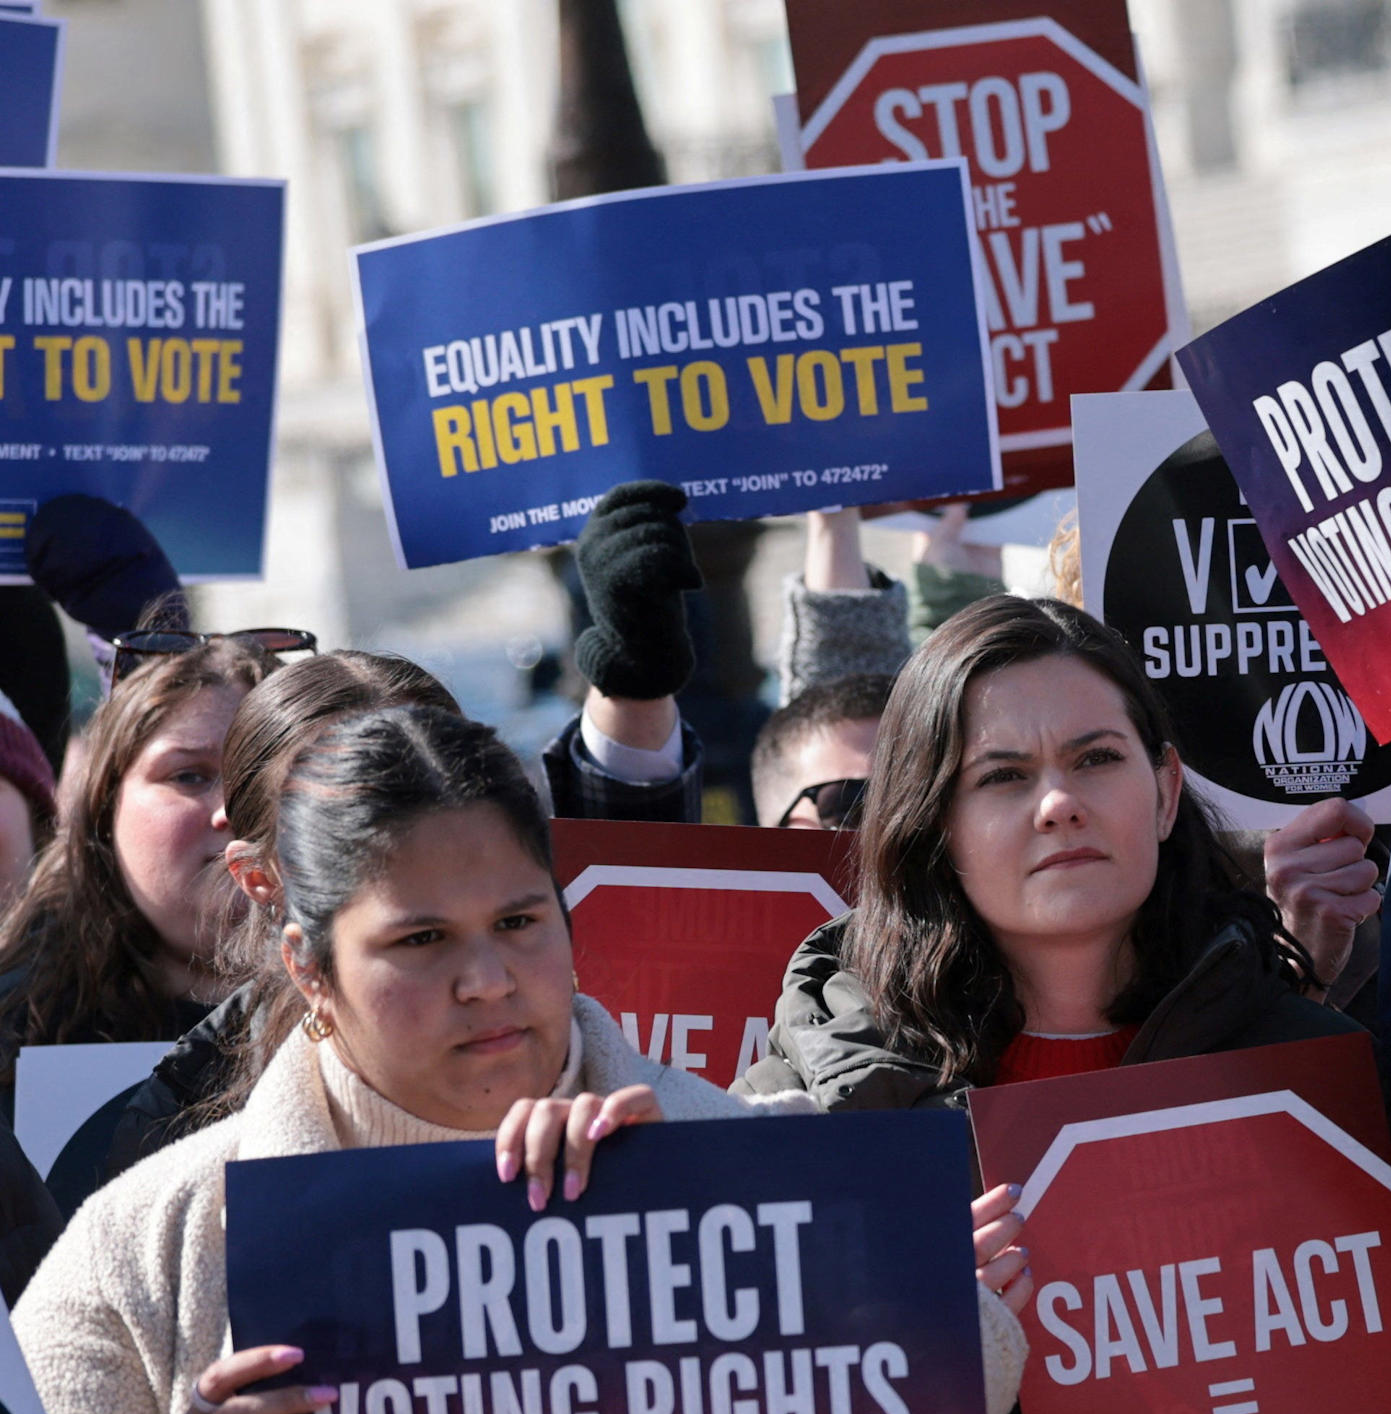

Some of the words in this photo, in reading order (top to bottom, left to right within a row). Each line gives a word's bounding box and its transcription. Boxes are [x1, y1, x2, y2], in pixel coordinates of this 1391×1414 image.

[874, 71, 1071, 178] STOP
[972, 182, 1022, 231] HE
[23, 278, 186, 329] INCLUDES
[191, 281, 245, 330] THE
[34, 335, 111, 402] TO
[127, 337, 244, 404] VOTE
[422, 313, 602, 398] EQUALITY
[615, 289, 824, 360] INCLUDES
[832, 281, 918, 336] THE
[990, 328, 1059, 408] CT
[432, 375, 614, 478] RIGHT
[634, 360, 729, 437] TO
[747, 342, 928, 426] VOTE
[63, 444, 104, 461] TEXT
[489, 510, 527, 534] JOIN
[527, 503, 560, 526] THE
[681, 478, 729, 497] TEXT
[791, 471, 817, 488] TO
[1143, 619, 1327, 679] SUPPRE
[1253, 681, 1366, 766] NOW
[1265, 764, 1358, 776] NATIONAL
[1273, 774, 1350, 786] ORGANIZATION
[1303, 783, 1341, 792] WOMEN
[620, 1012, 713, 1071] VE
[390, 1201, 814, 1365] PROTECT
[1036, 1257, 1237, 1386] SAVE
[1252, 1230, 1383, 1354] ACT
